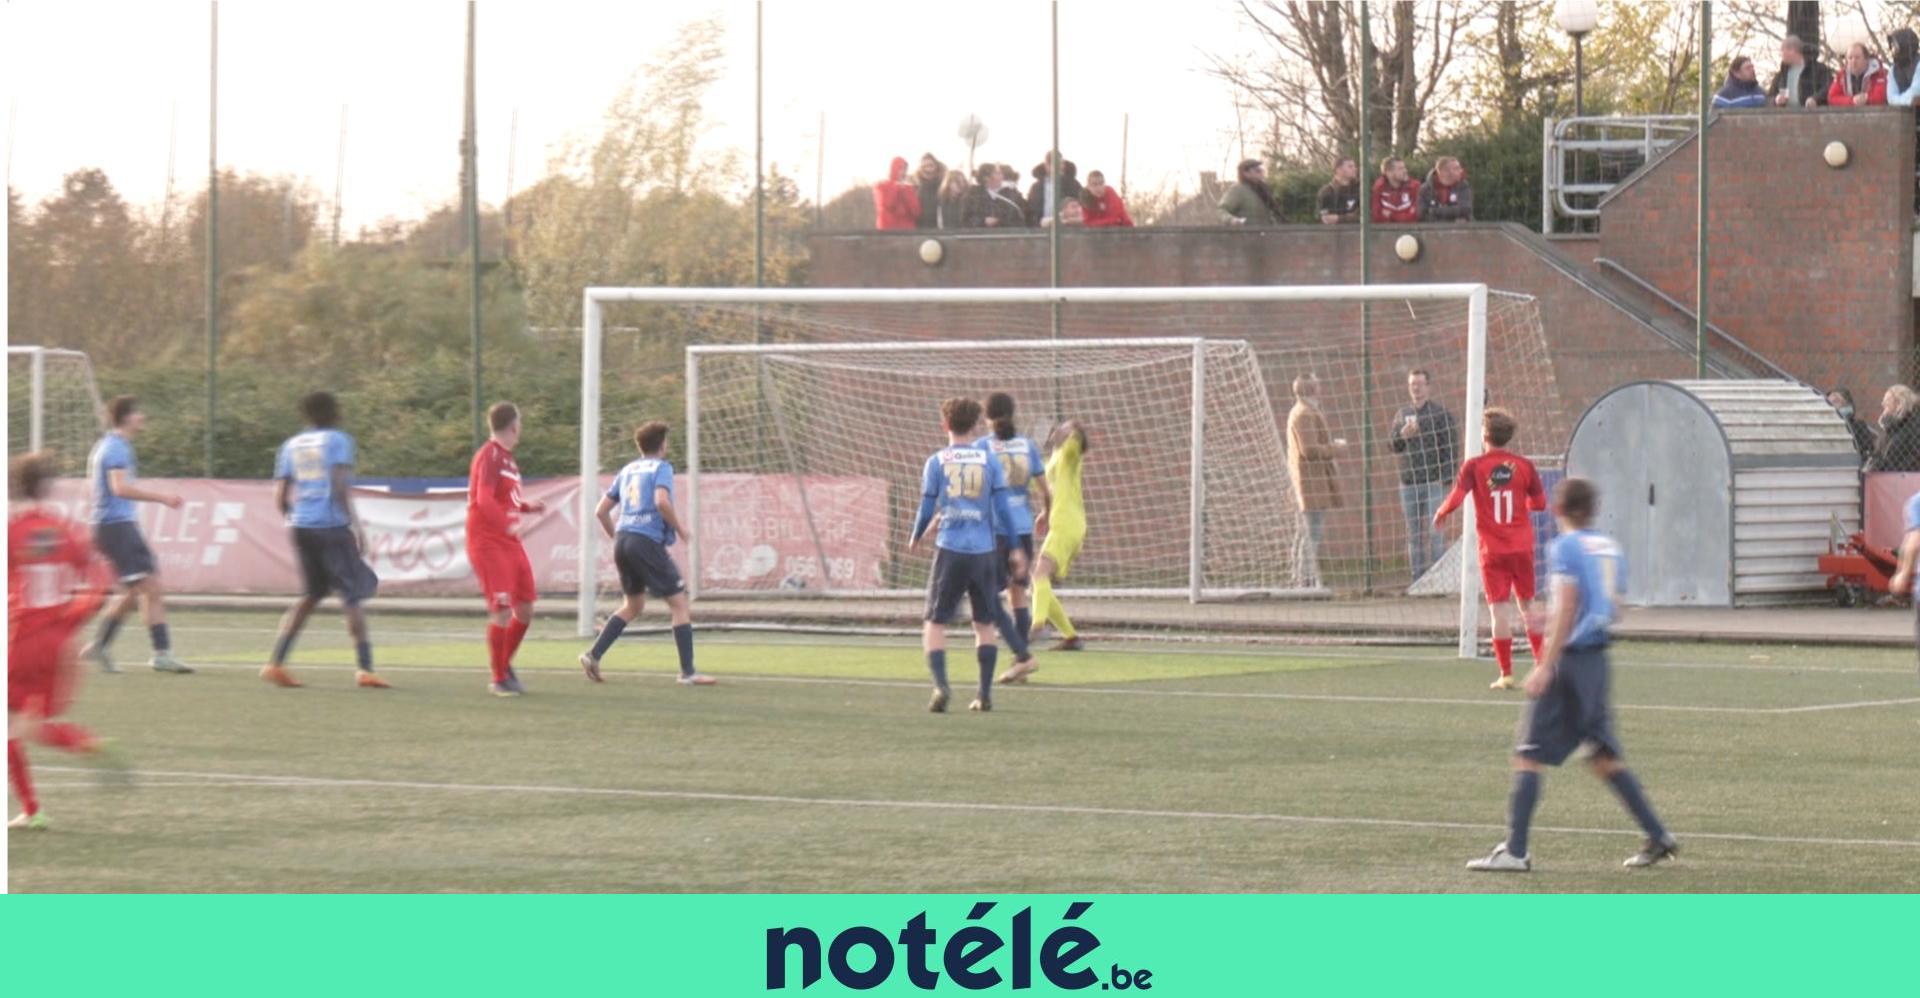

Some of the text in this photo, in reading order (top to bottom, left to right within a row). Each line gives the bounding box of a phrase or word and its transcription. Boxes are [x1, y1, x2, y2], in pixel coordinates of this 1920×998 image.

[625, 473, 642, 509] 4
[943, 463, 984, 498] 30
[1489, 490, 1514, 525] 11
